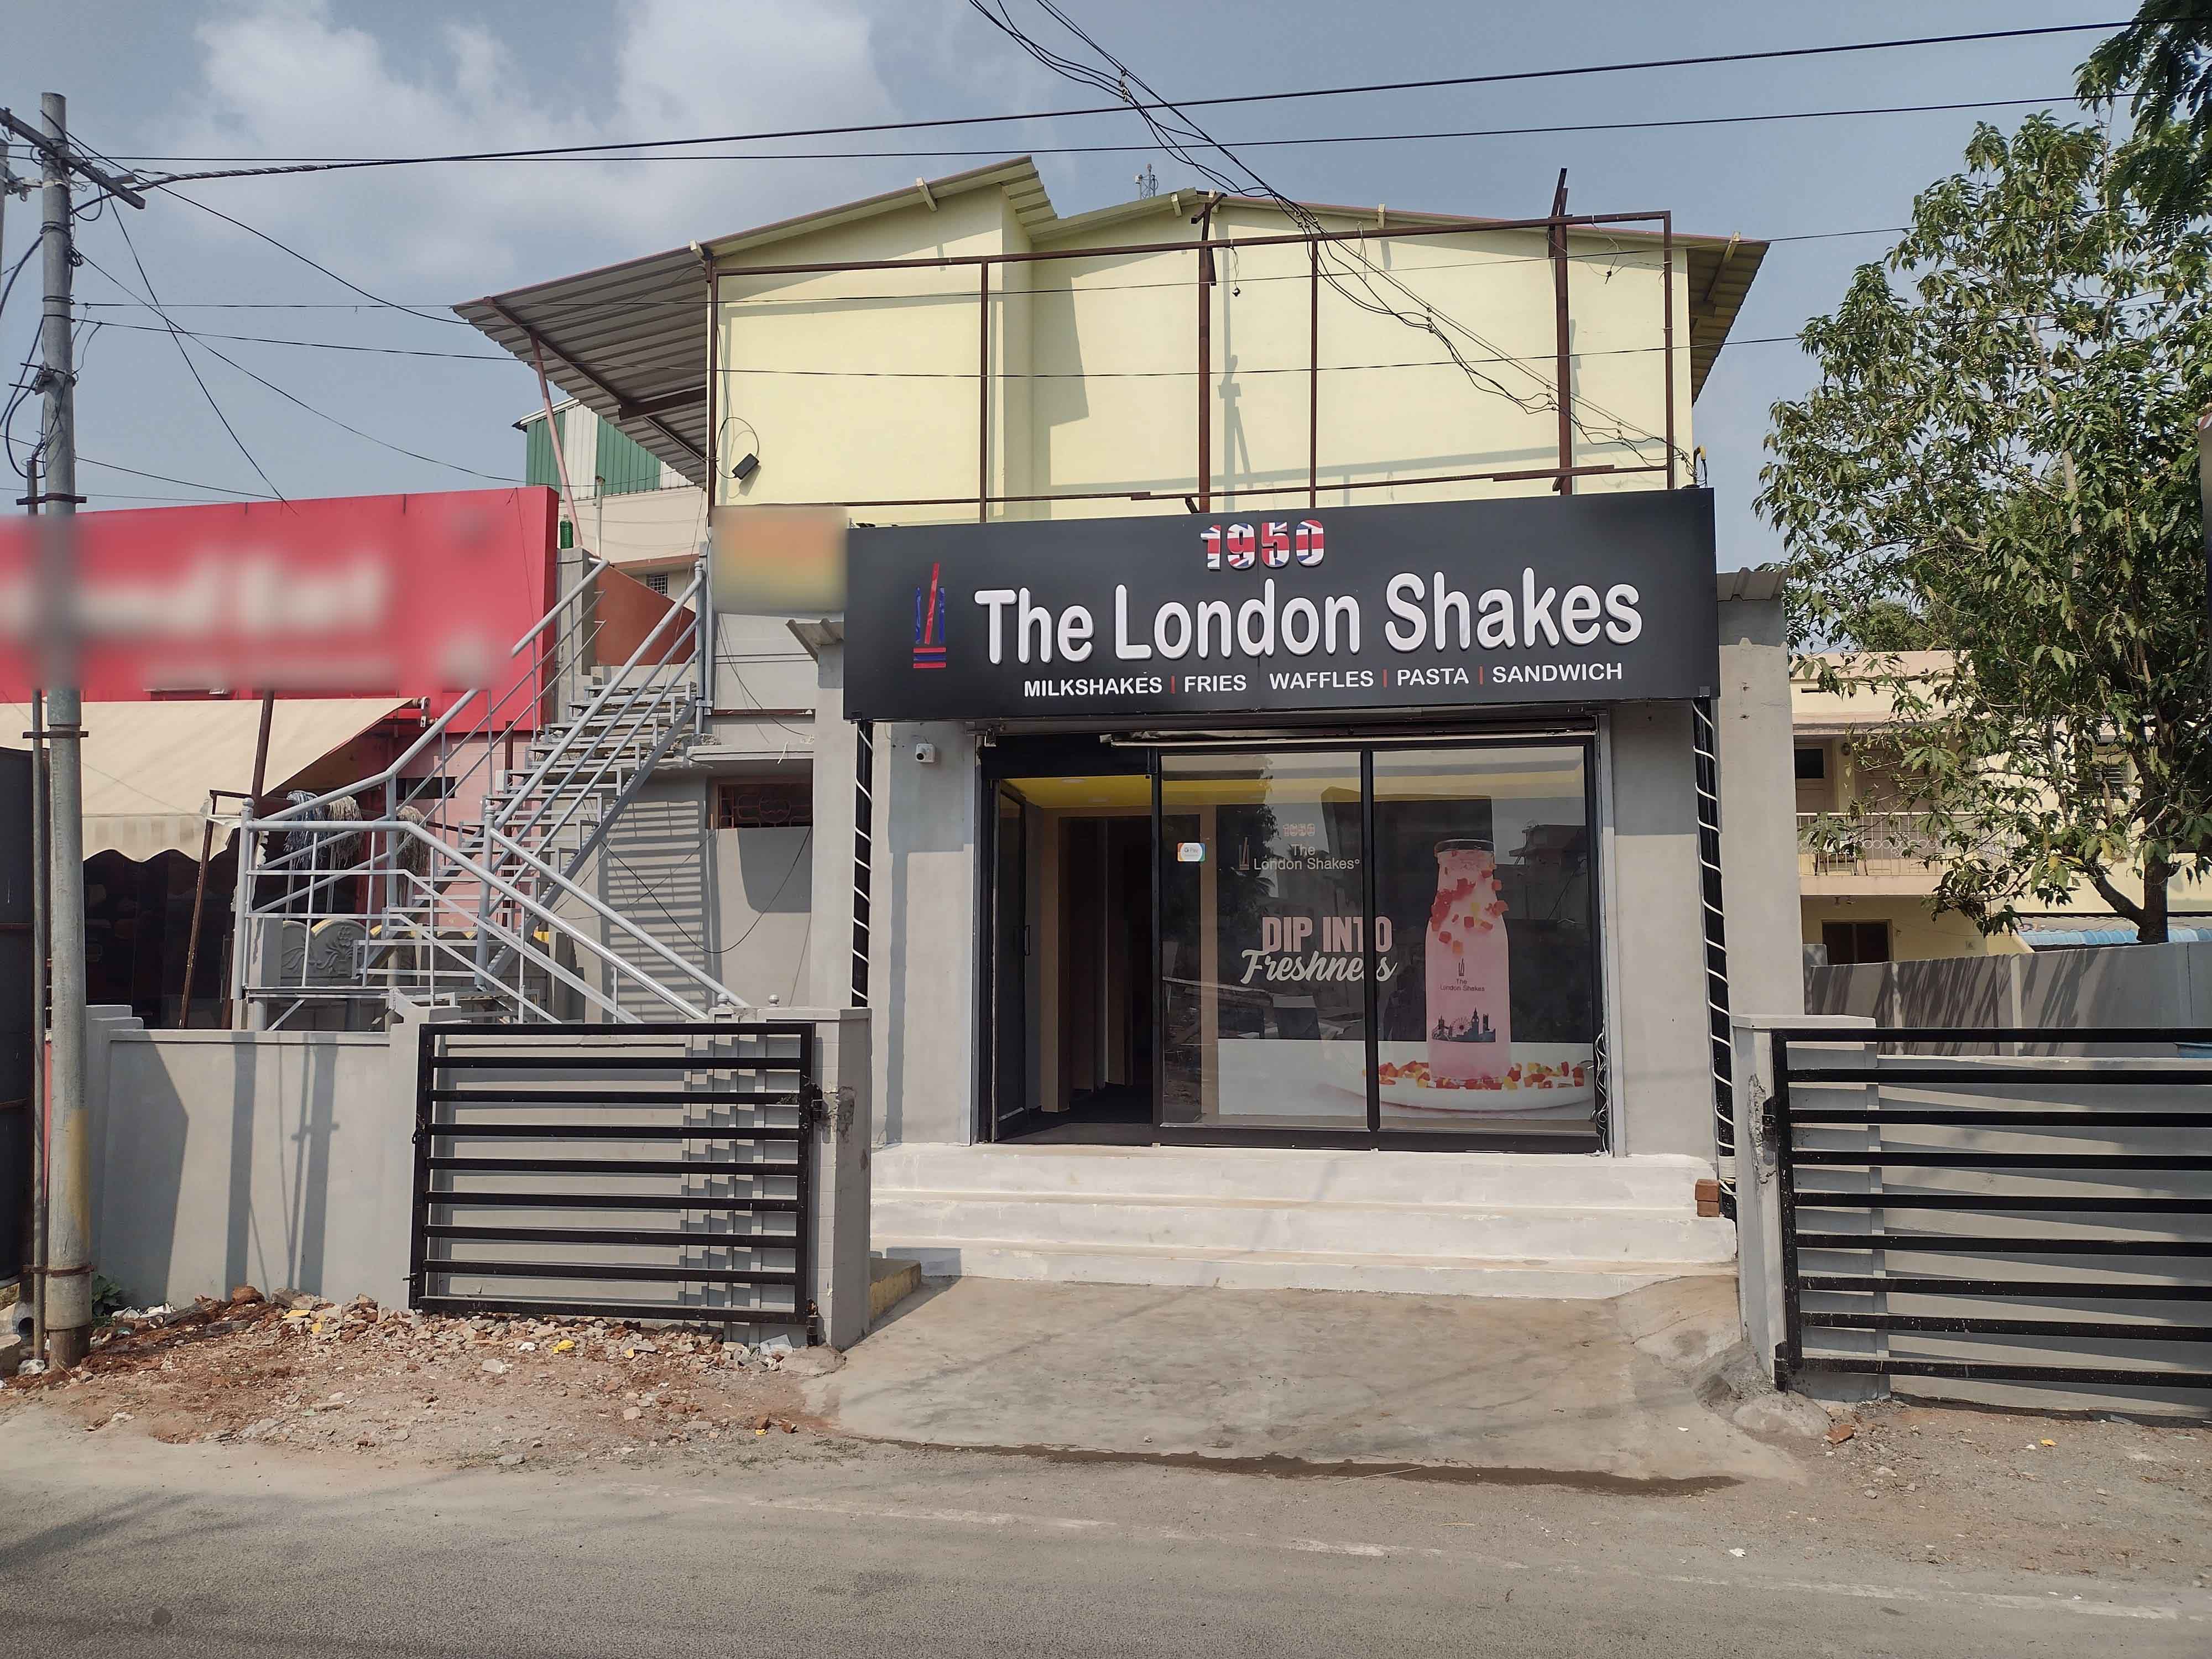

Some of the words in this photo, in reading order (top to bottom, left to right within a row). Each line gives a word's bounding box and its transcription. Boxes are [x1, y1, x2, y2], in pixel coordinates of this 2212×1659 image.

[1200, 519, 1325, 570] 1950
[974, 586, 1094, 664] The
[1115, 578, 1361, 660] London
[1385, 567, 1642, 652] Shakes
[1024, 676, 1162, 697] MILKSHAKES
[1184, 674, 1247, 693] FRIES
[1269, 670, 1374, 690] WAFFLES
[1397, 667, 1469, 686] PASTA
[1492, 662, 1623, 684] SANDWICH
[1254, 858, 1302, 870] London
[1291, 844, 1316, 856] The
[1262, 916, 1313, 952] DIP
[1240, 949, 1398, 984] Freshnes
